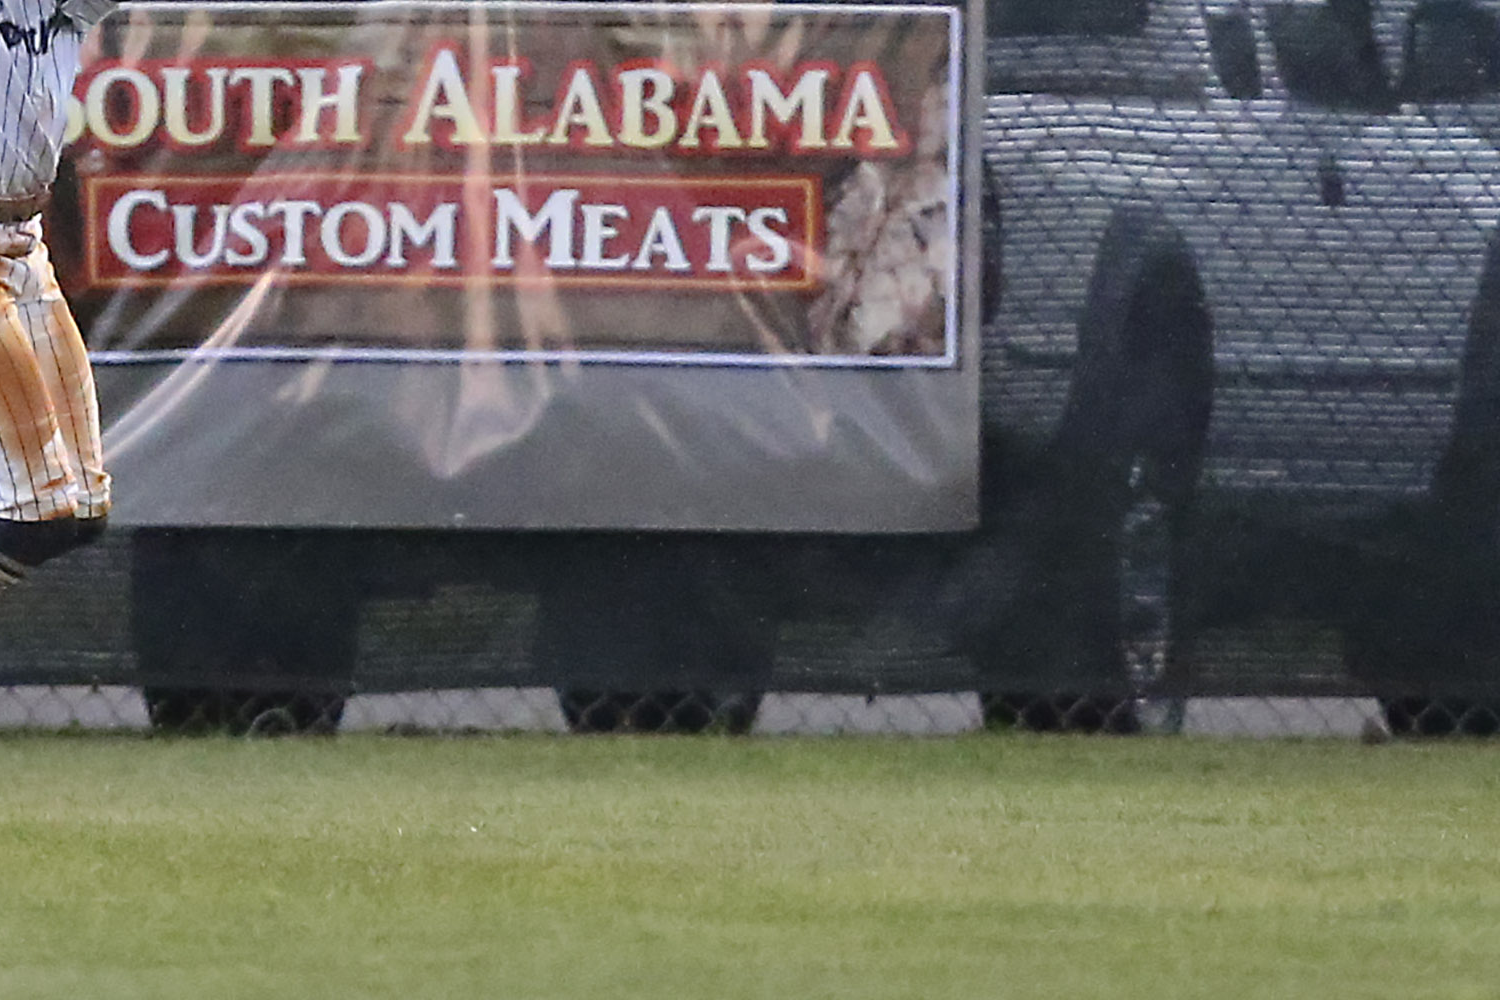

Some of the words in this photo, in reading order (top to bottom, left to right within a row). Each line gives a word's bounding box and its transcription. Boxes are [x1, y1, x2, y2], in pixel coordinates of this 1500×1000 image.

[63, 65, 364, 147] OUTH
[402, 49, 901, 151] ALABAMA
[106, 189, 459, 272] CUSTOM
[494, 189, 792, 274] MEATS
